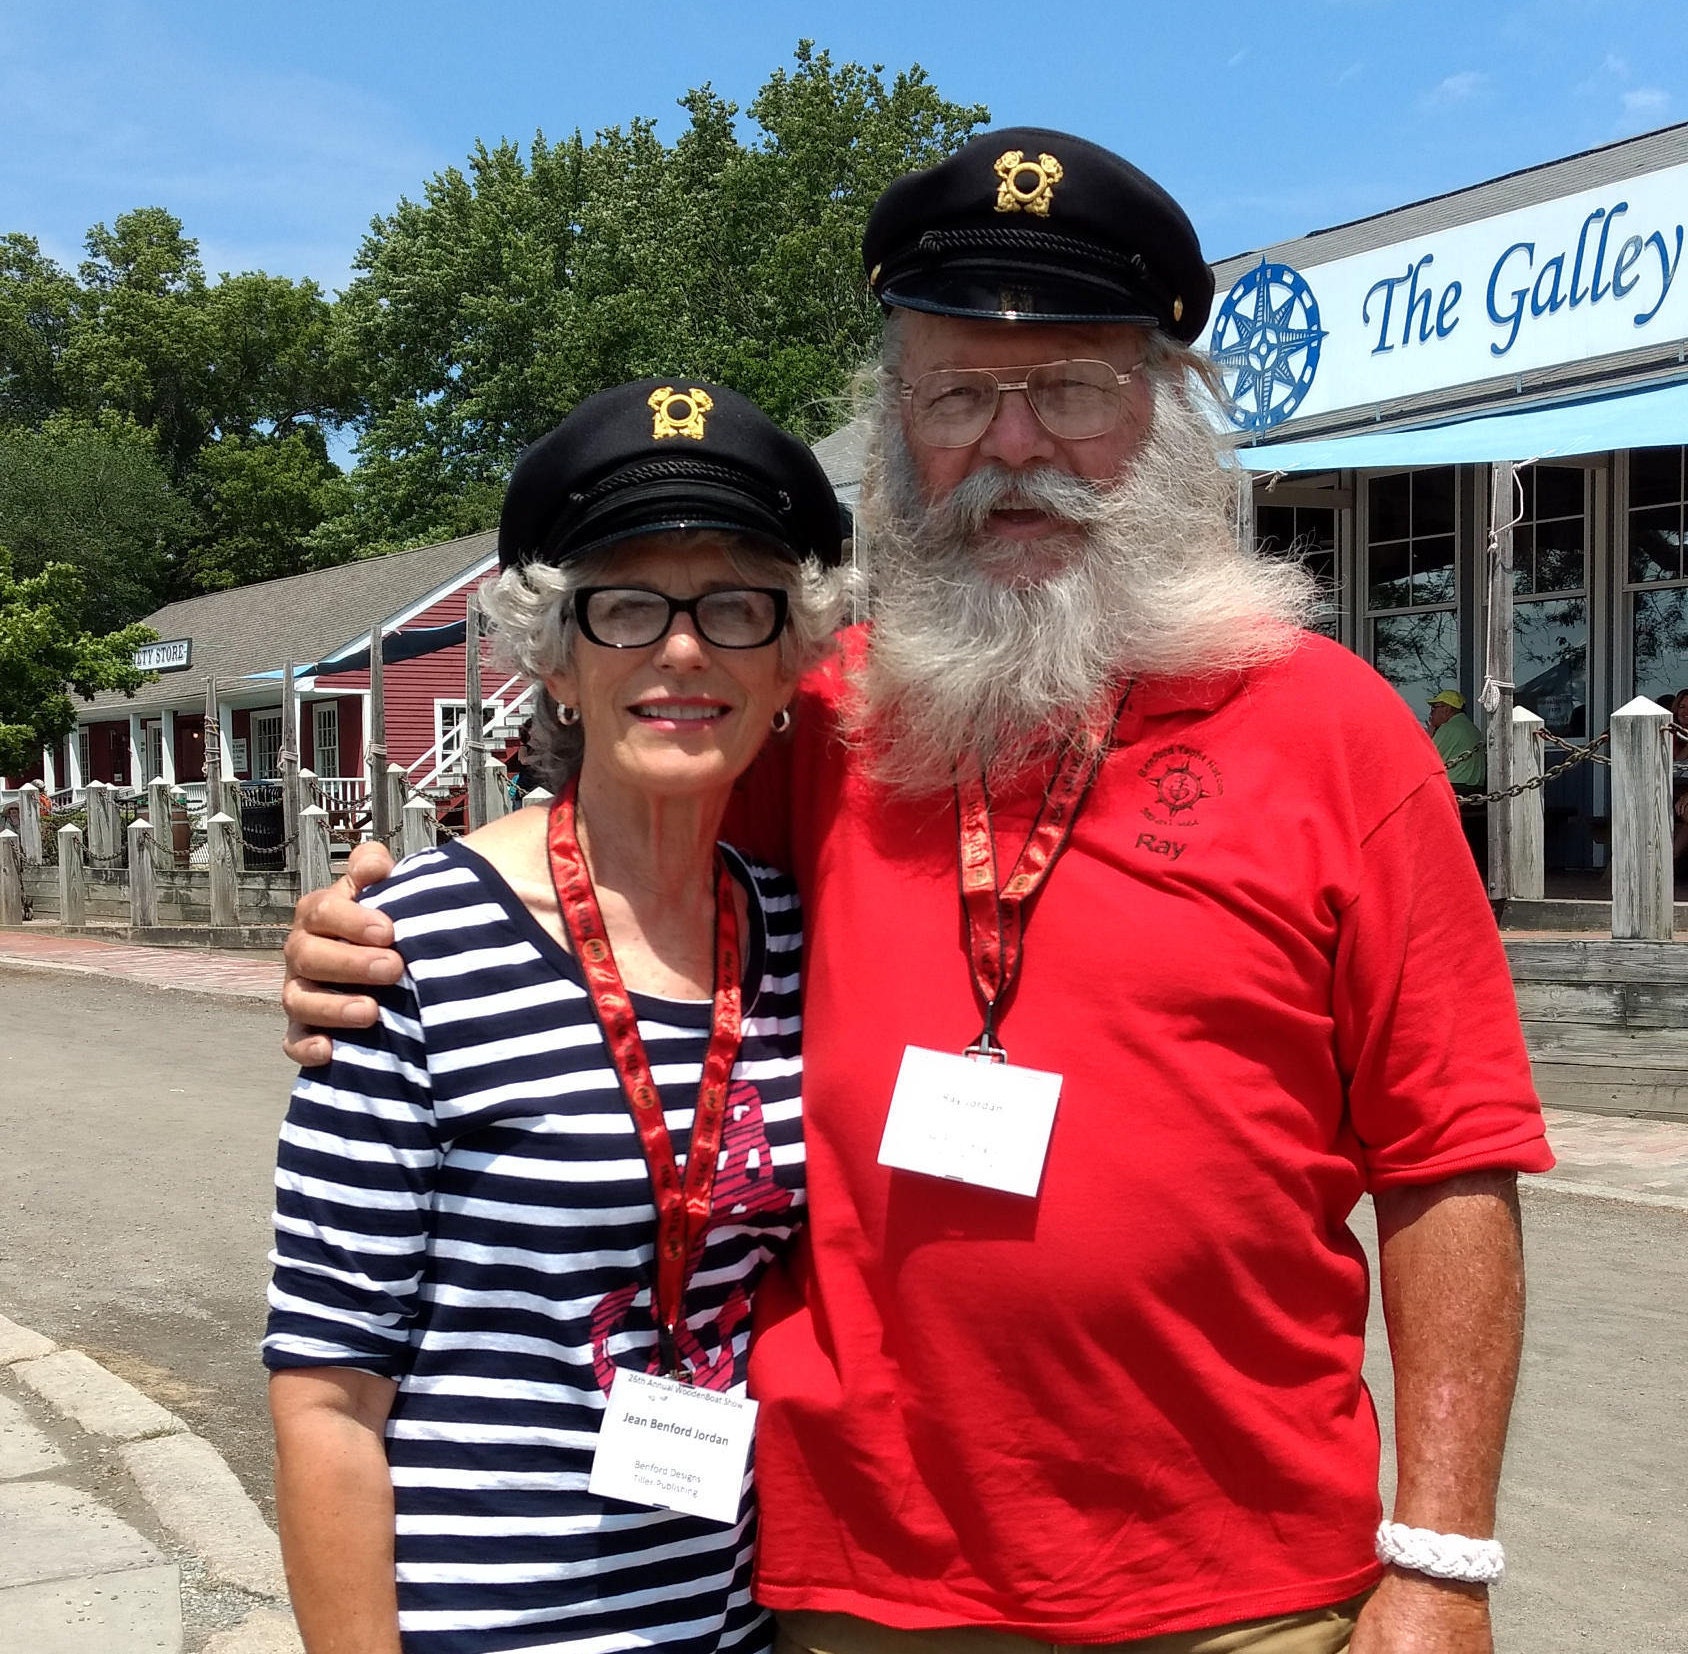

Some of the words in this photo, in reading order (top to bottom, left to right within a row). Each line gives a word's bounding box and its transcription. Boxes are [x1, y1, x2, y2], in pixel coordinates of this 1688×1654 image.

[1363, 253, 1463, 356] The
[1485, 201, 1684, 357] Galley
[155, 644, 184, 664] STORE
[1135, 833, 1188, 861] Ray
[647, 1379, 674, 1392] Annual
[724, 1397, 744, 1410] Show
[623, 1412, 648, 1427] Jean
[650, 1418, 692, 1437] Benford
[693, 1428, 729, 1446] Jordan
[634, 1460, 668, 1476] Benford
